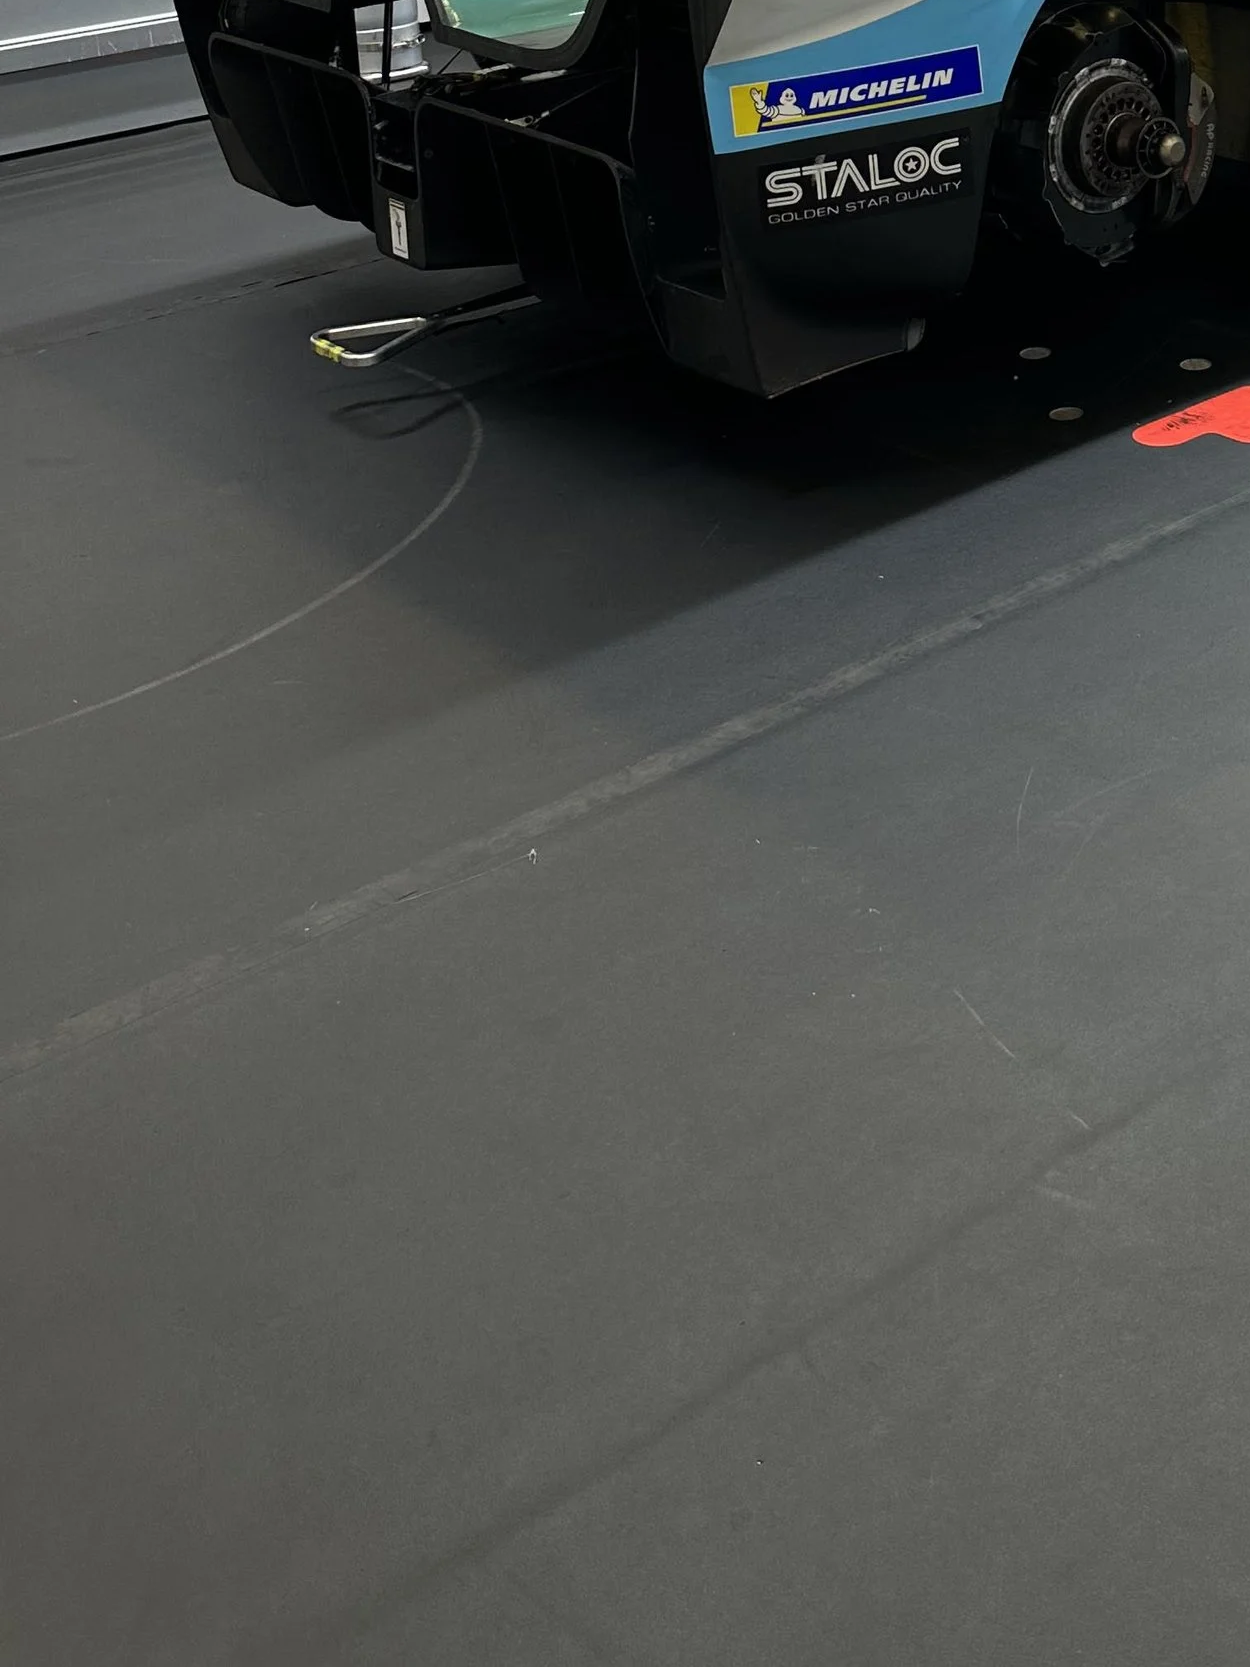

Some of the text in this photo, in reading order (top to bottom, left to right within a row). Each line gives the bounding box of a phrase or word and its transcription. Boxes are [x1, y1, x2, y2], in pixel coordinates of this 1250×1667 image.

[809, 68, 954, 110] MICHELIN
[765, 137, 962, 209] STALOC
[768, 180, 962, 225] GOLDEN STAR QUALITY
